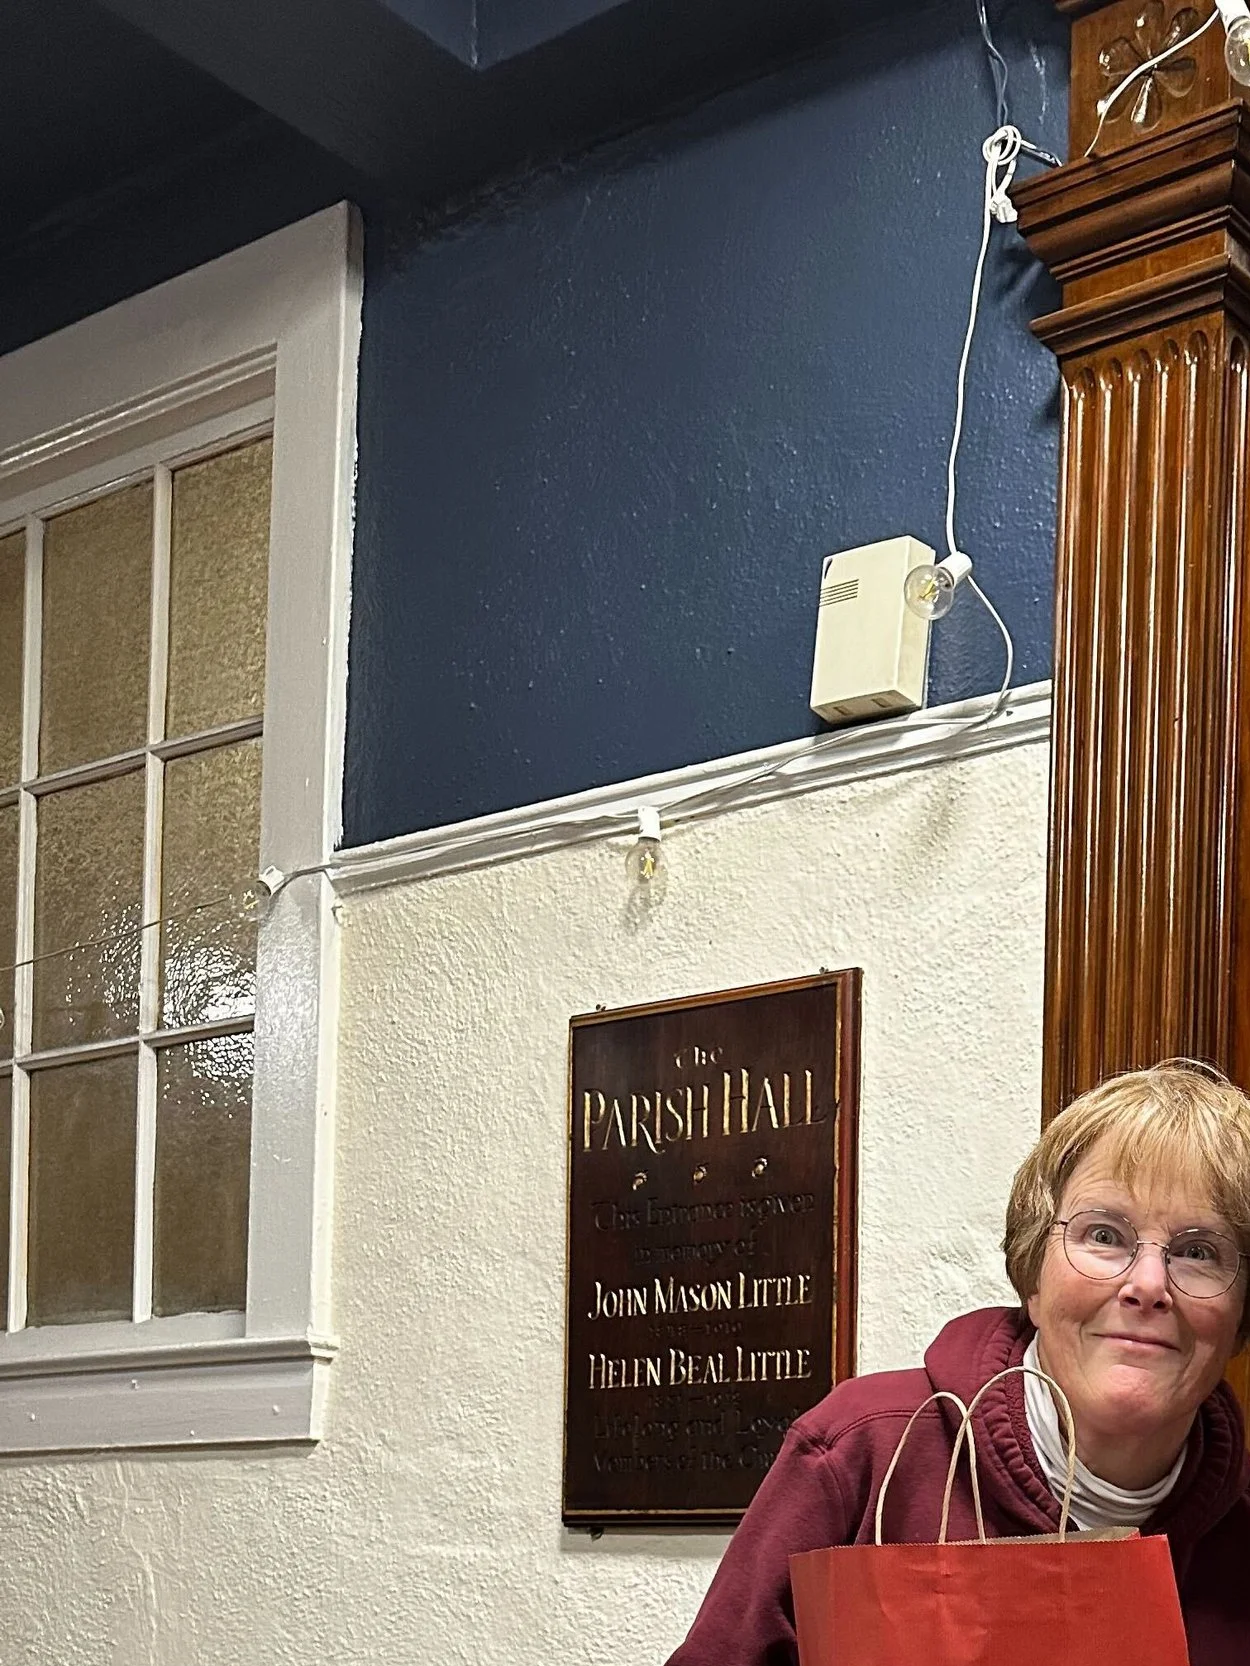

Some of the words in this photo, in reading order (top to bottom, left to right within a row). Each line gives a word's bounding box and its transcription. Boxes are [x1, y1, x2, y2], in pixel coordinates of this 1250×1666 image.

[582, 1084, 710, 1154] PARISH
[721, 1068, 826, 1137] HALL
[587, 1280, 648, 1321] JOHN
[653, 1274, 733, 1315] MASON
[737, 1271, 813, 1311] LITTLE
[588, 1352, 662, 1391] HELEN
[669, 1347, 731, 1387] BEAL
[736, 1345, 812, 1383] LITTLE
